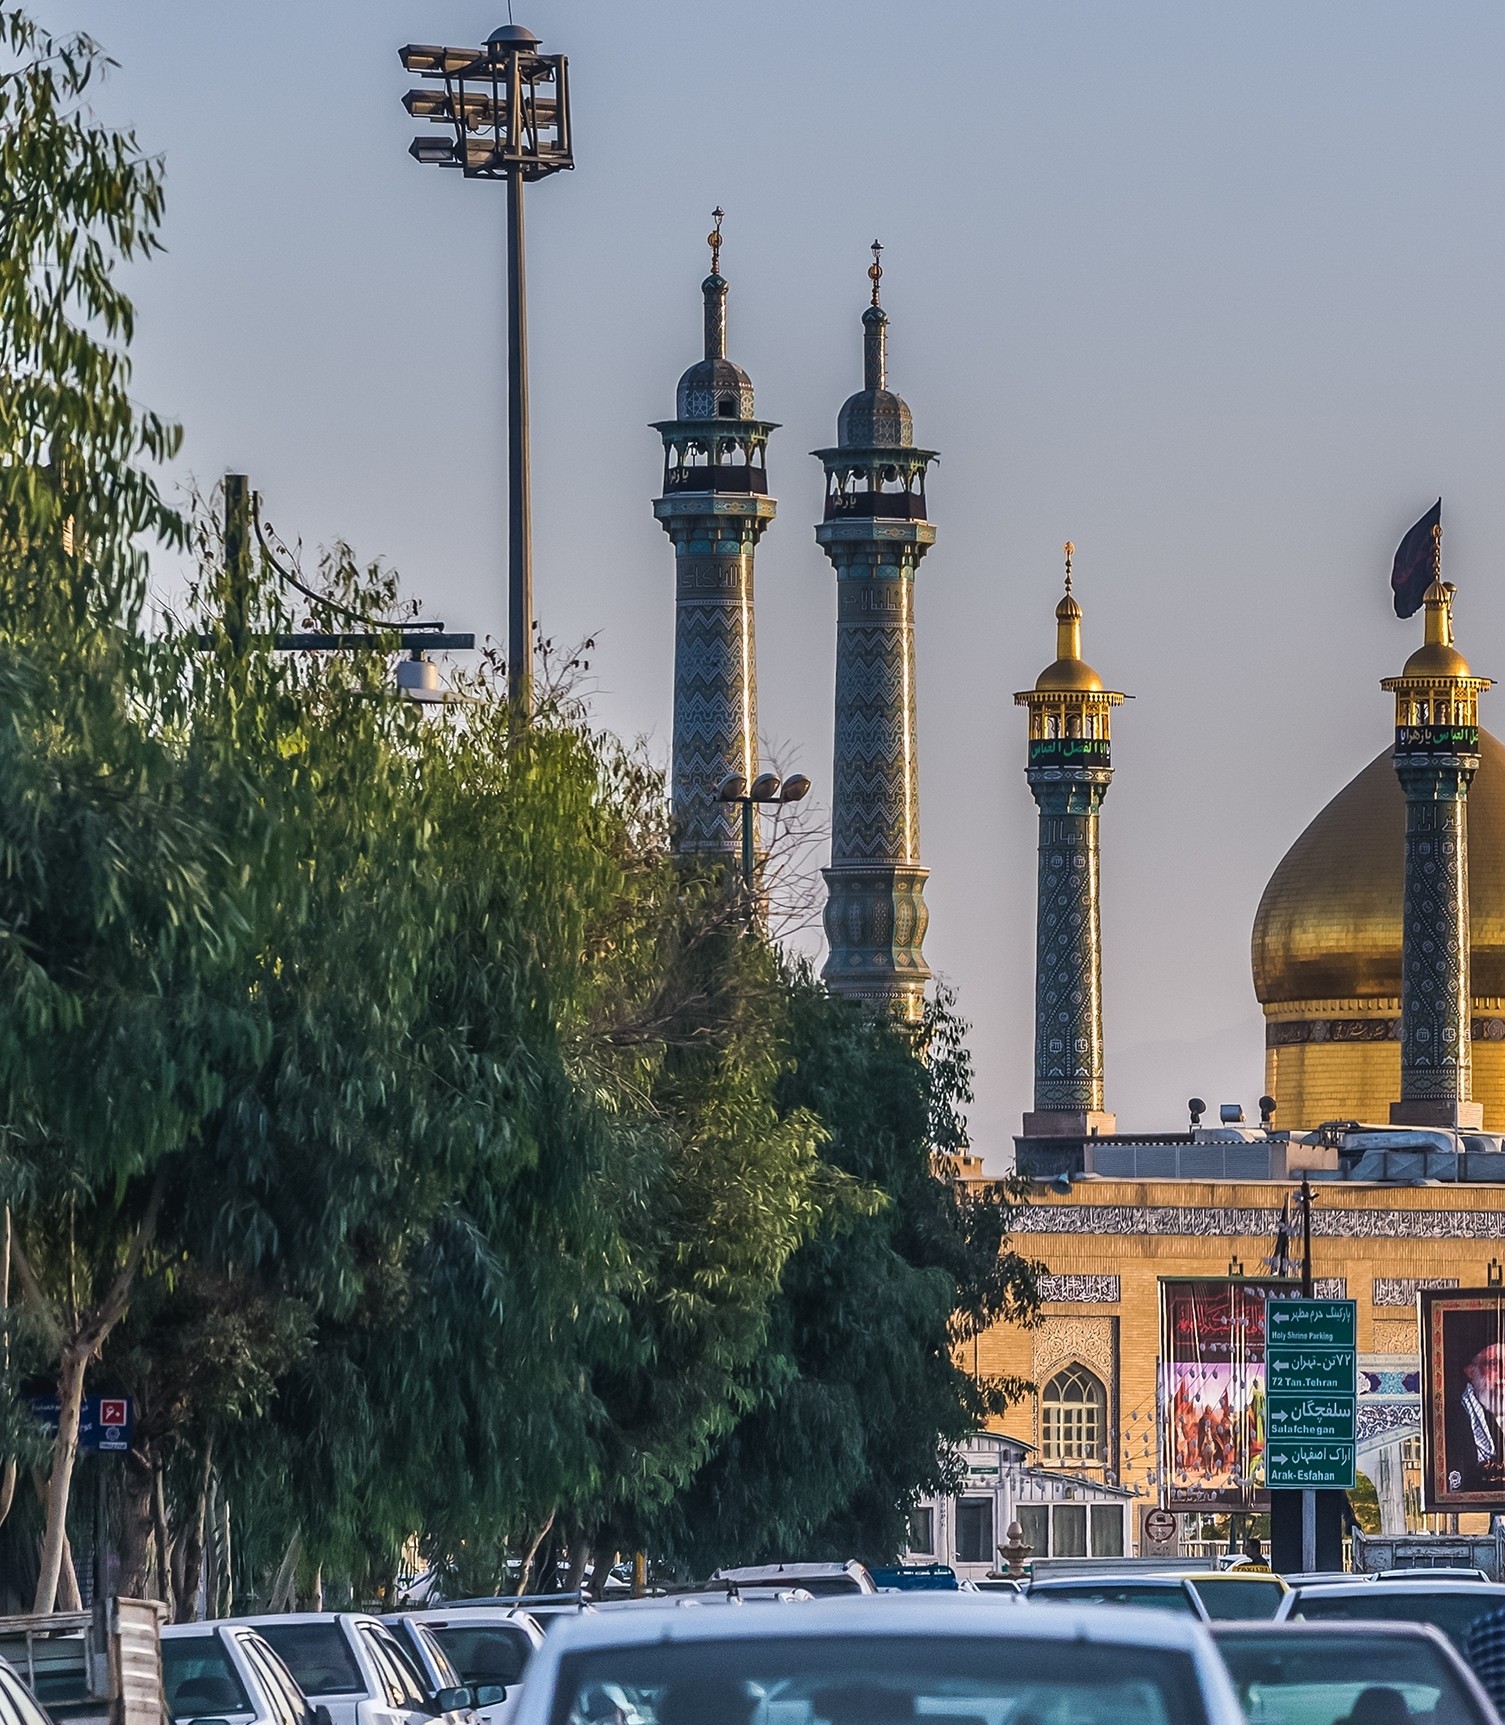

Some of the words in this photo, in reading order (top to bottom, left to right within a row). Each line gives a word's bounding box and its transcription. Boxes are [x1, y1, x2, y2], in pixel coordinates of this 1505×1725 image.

[1290, 1307, 1309, 1322] مطهر
[1309, 1309, 1324, 1323] حرم
[1325, 1306, 1351, 1323] پارکینگ
[1271, 1331, 1287, 1341] Holy
[1287, 1331, 1308, 1339] Shrine
[1308, 1332, 1334, 1342] Parking
[1271, 1377, 1283, 1386] 72
[1290, 1399, 1351, 1424] سلفچگان
[1271, 1424, 1335, 1436] Salafchegan
[1291, 1447, 1327, 1465] اصفهان
[1329, 1447, 1351, 1466] اراک
